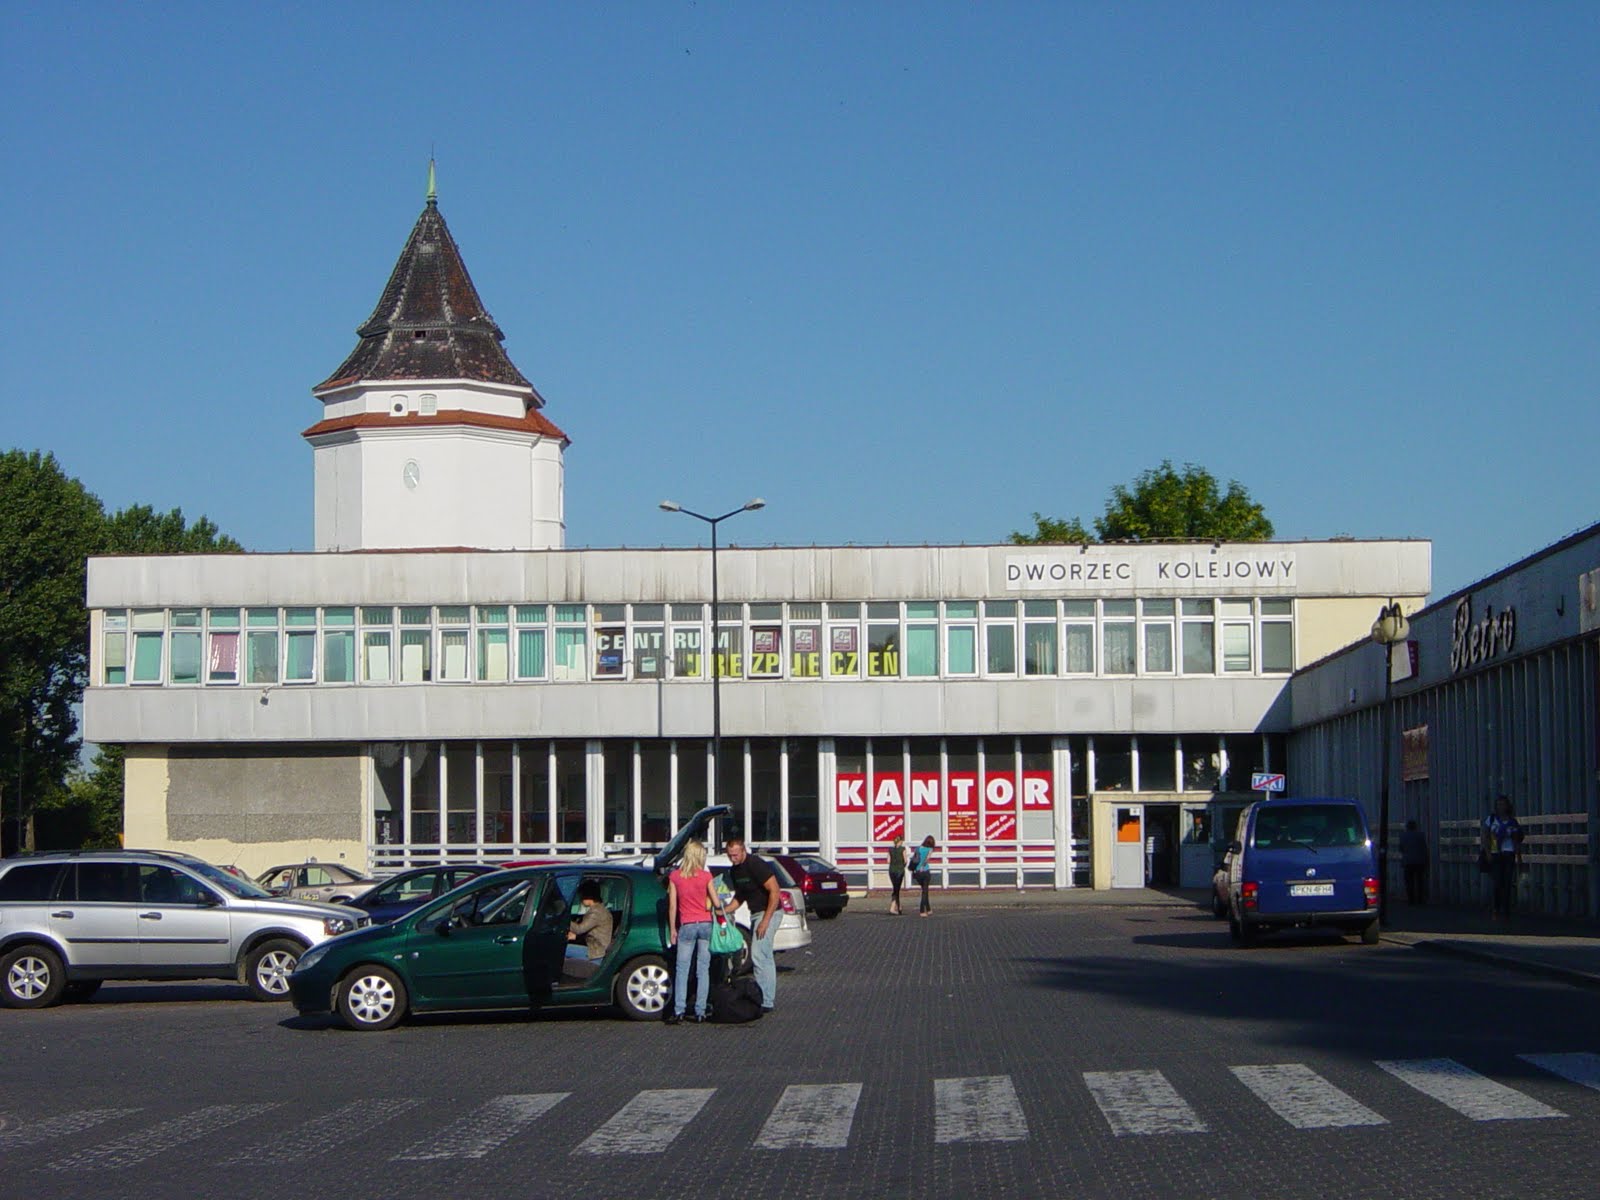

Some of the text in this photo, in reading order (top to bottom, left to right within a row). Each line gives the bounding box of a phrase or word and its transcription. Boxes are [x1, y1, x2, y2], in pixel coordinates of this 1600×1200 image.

[1007, 560, 1294, 581] DWORZEC KOLEJOWY
[597, 632, 730, 650] CENTRUM
[838, 777, 1050, 806] KANTOR
[1253, 775, 1283, 790] TAXI
